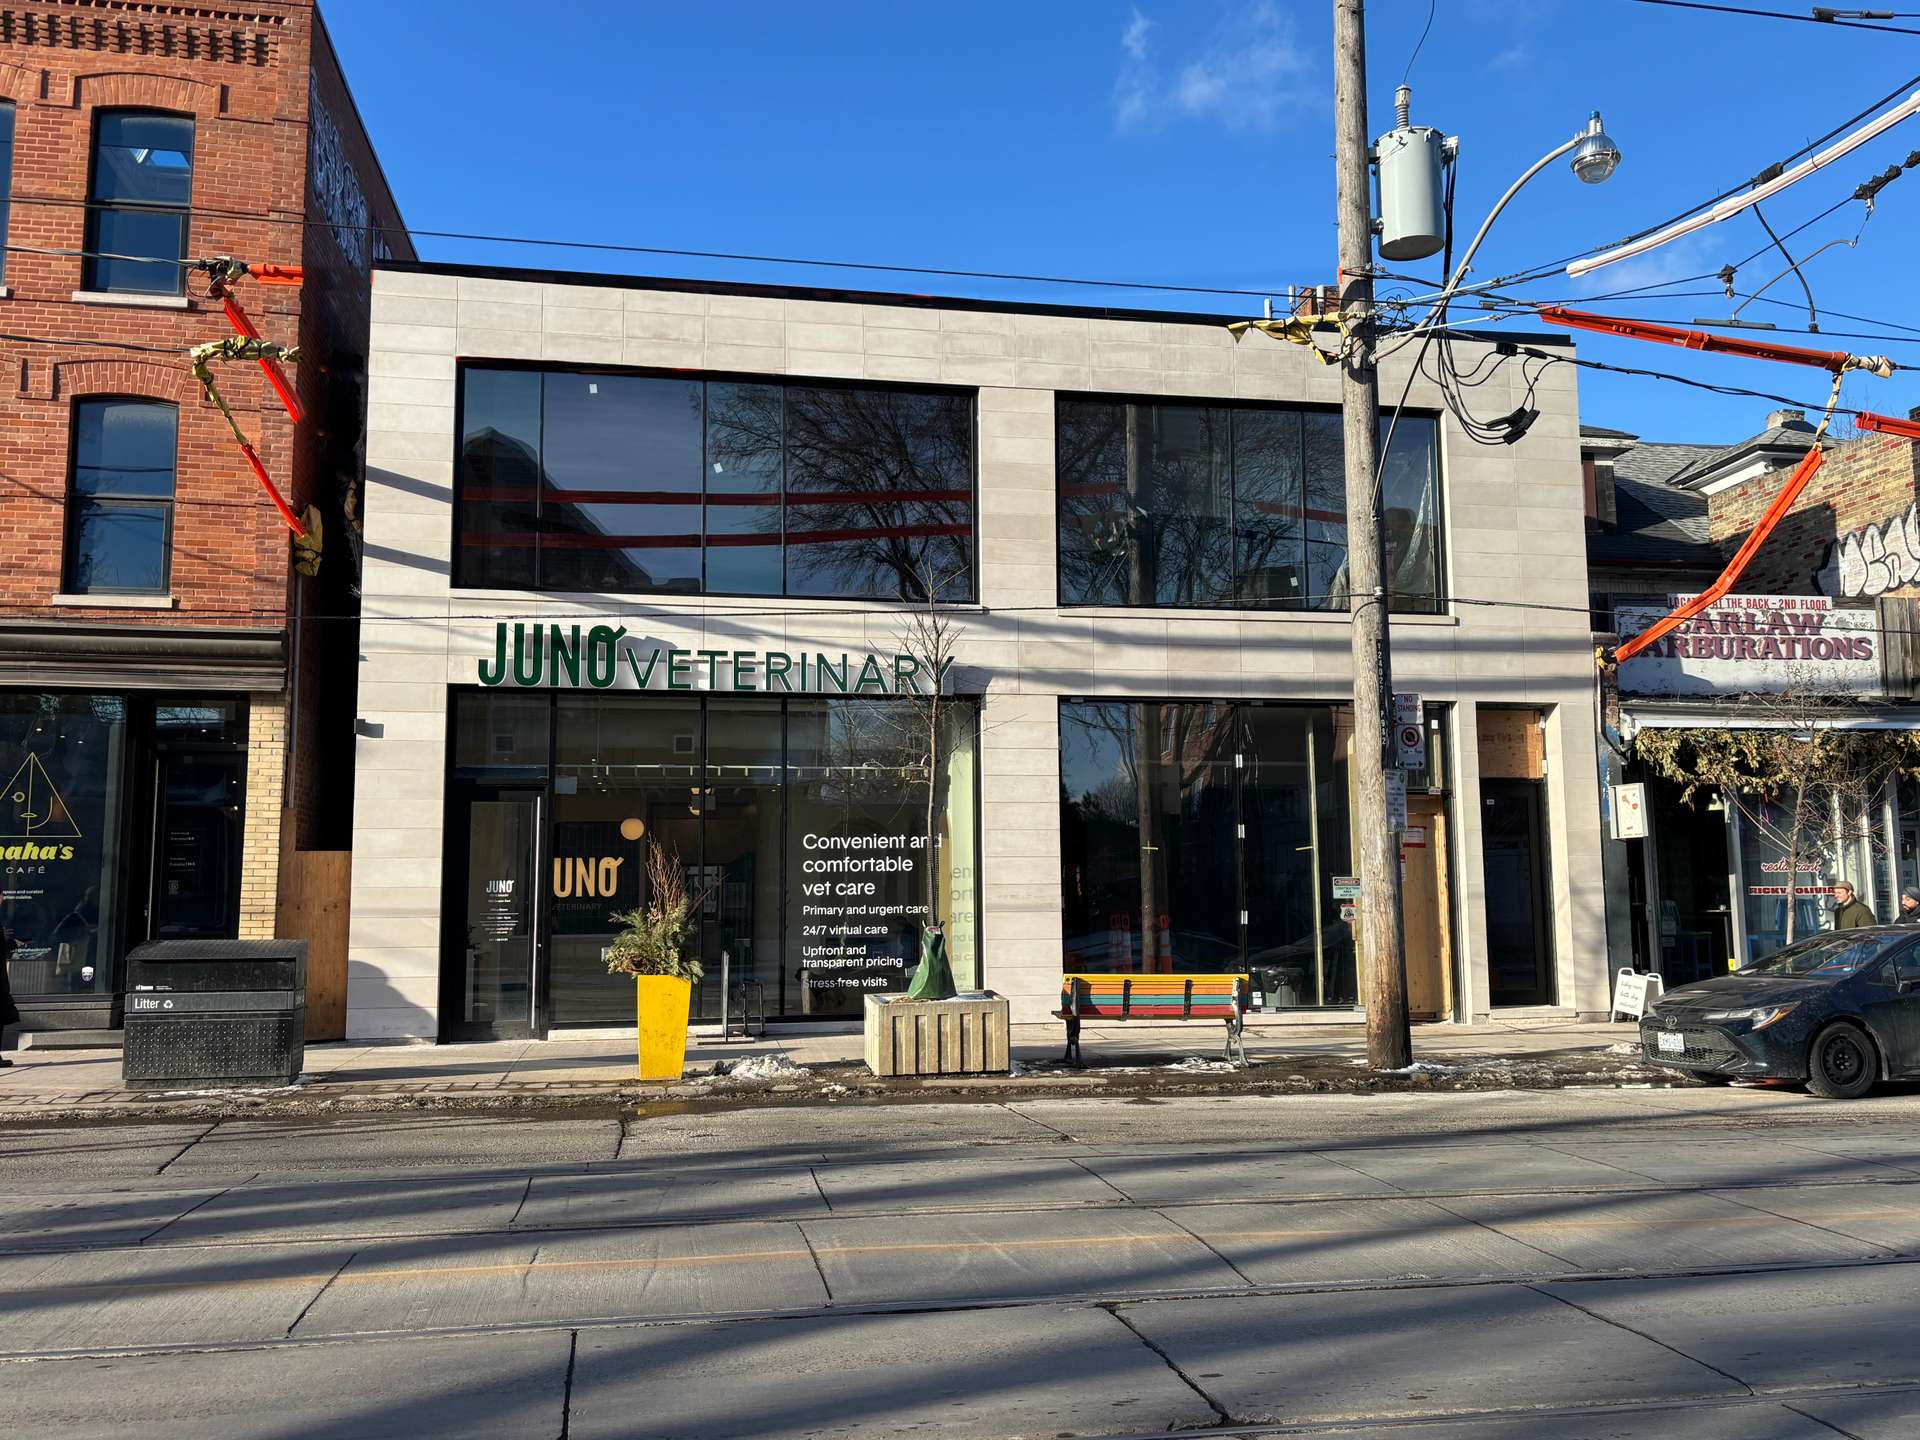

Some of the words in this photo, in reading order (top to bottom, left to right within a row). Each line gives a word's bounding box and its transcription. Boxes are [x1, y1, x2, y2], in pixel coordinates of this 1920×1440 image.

[1727, 598, 1742, 608] THE
[1746, 598, 1769, 609] BACK
[1779, 599, 1796, 609] 2ND
[1801, 600, 1827, 610] FLOOR
[478, 622, 627, 688] JUNO
[626, 647, 955, 695] VETERINARY
[1403, 695, 1413, 703] NO
[1397, 704, 1421, 713] STANDING
[802, 833, 906, 849] Convenient
[5, 865, 46, 874] CAFÉ
[802, 856, 913, 872] comfortable
[553, 856, 625, 898] UNO
[486, 879, 515, 893] JUNO
[802, 881, 831, 896] vet
[835, 882, 875, 895] care
[802, 905, 844, 916] Primary
[846, 904, 866, 915] and
[868, 904, 903, 916] urgent
[905, 905, 929, 914] care
[802, 925, 826, 935] 24/7
[829, 925, 862, 935] virtual
[865, 926, 888, 935] care
[802, 946, 845, 957] Upfront
[846, 945, 867, 955] and
[802, 957, 863, 969] transparent
[865, 956, 903, 968] pricing
[861, 976, 888, 987] visits
[134, 998, 160, 1009] Litter
